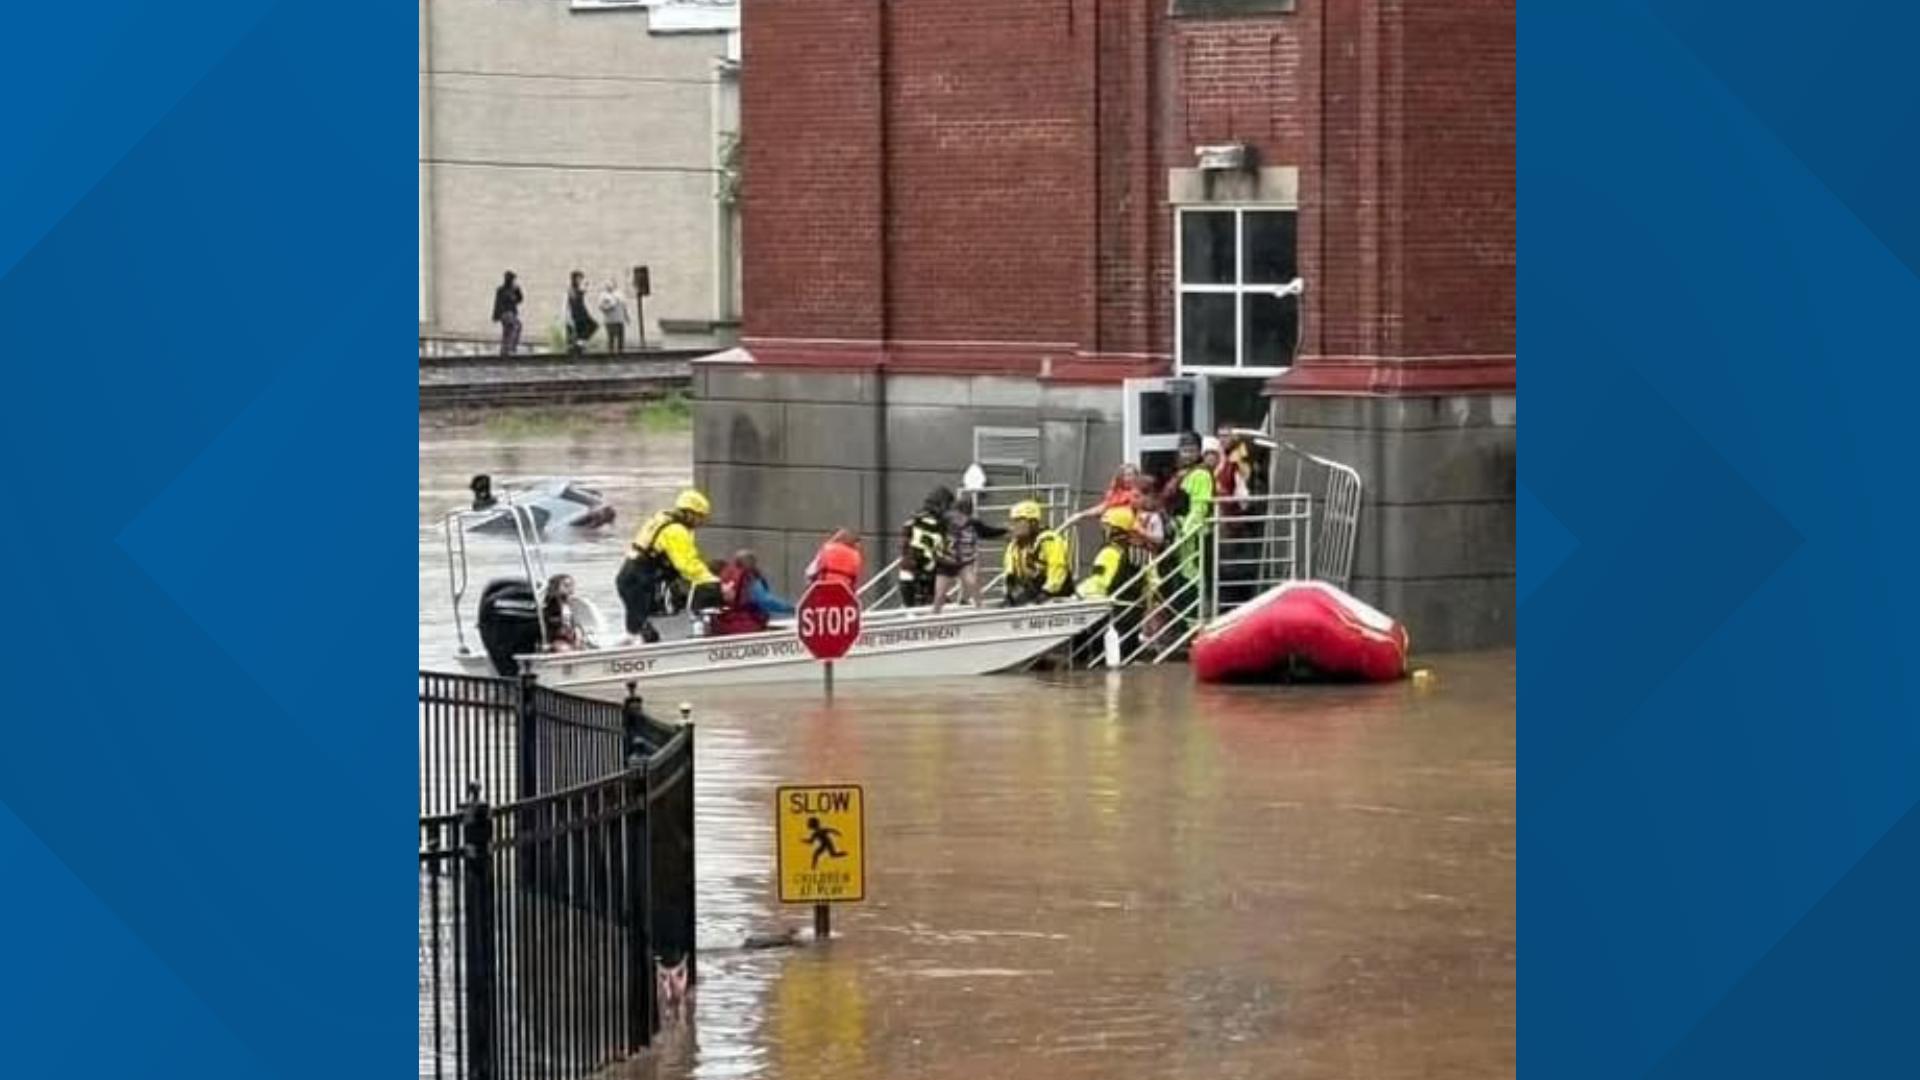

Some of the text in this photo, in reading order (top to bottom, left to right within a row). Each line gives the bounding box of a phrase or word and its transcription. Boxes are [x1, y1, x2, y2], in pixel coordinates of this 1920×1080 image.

[802, 606, 857, 637] STOP
[708, 643, 768, 662] OAKLAND
[879, 625, 961, 645] DEPARTMENT
[790, 792, 850, 814] SLOW
[792, 872, 850, 884] CHILDREN
